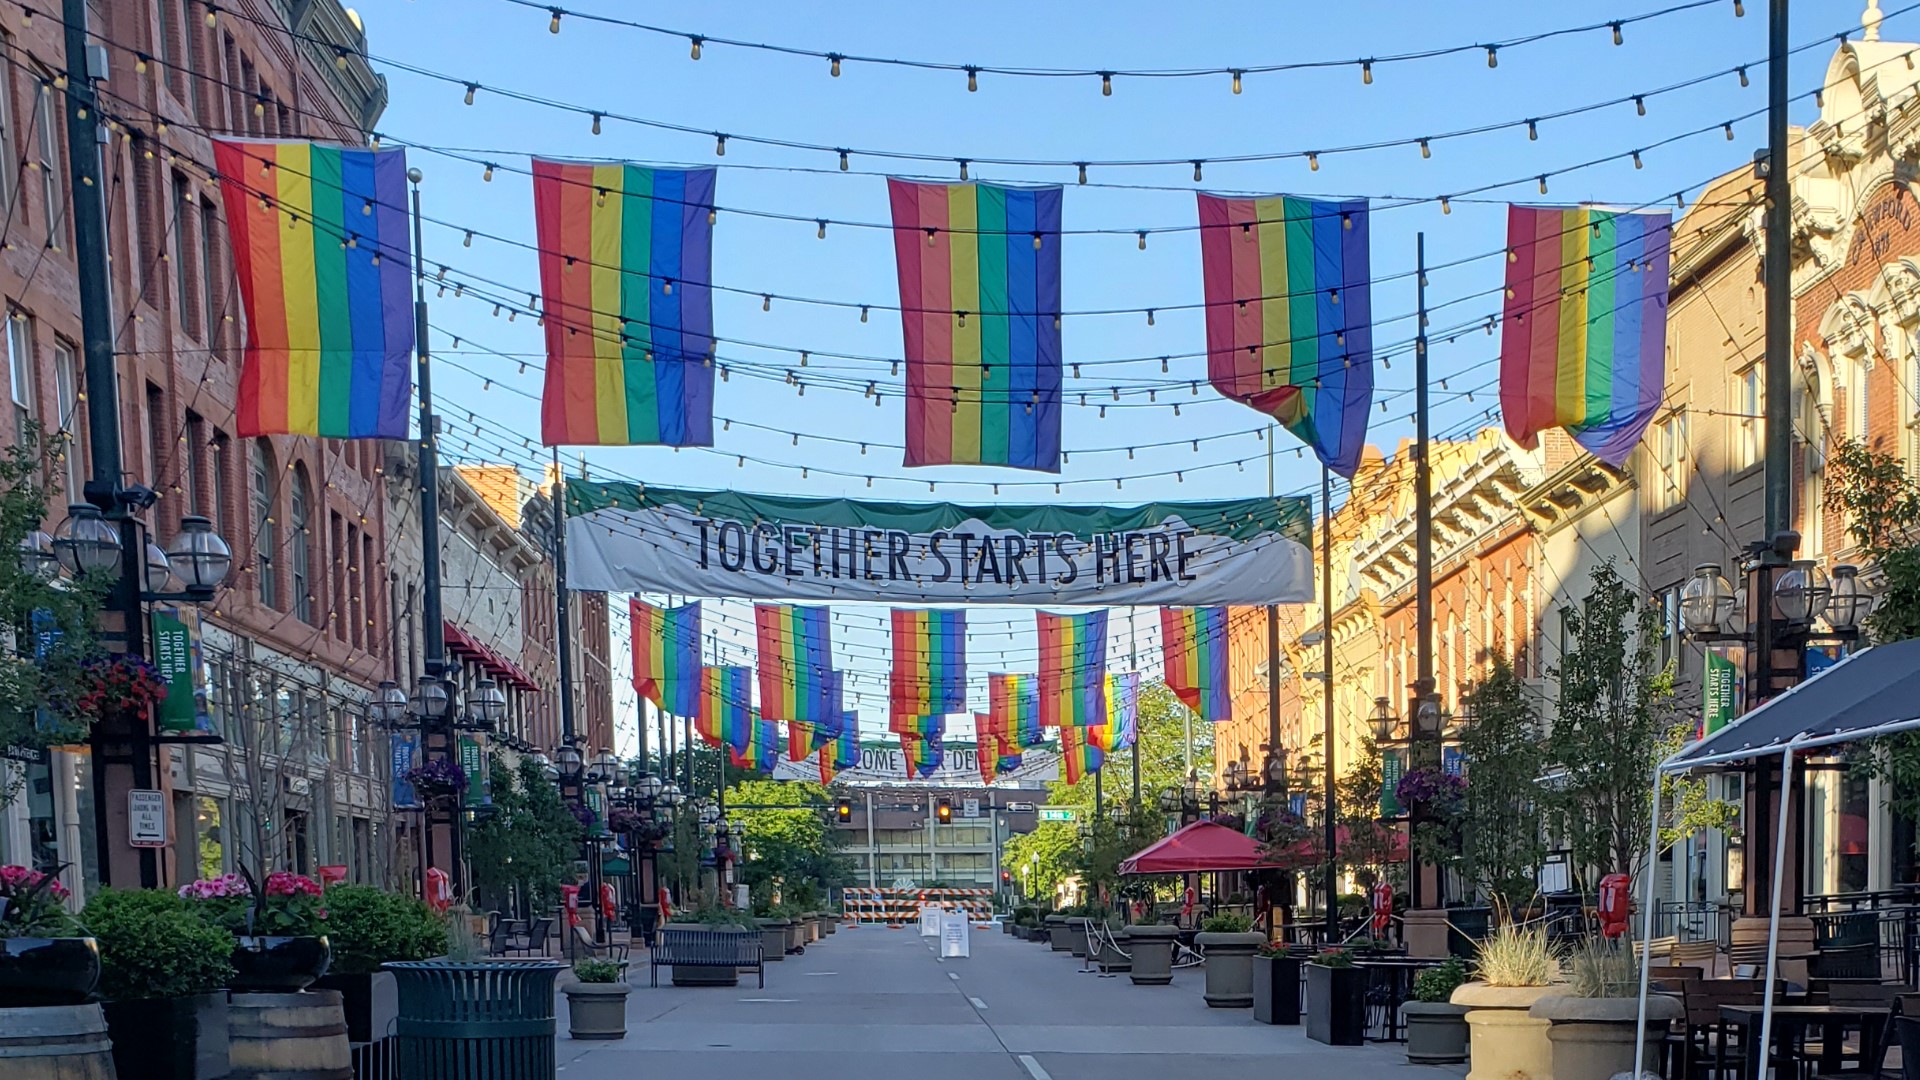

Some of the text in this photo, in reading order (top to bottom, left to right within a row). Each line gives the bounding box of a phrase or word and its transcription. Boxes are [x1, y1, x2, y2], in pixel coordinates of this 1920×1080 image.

[692, 519, 1196, 585] TOGETHER STARTS HERE
[159, 631, 172, 661] STARTS
[173, 631, 186, 673] TOGETHER
[1709, 669, 1719, 718] STARTS HERE
[1721, 669, 1730, 707] TOGETHER
